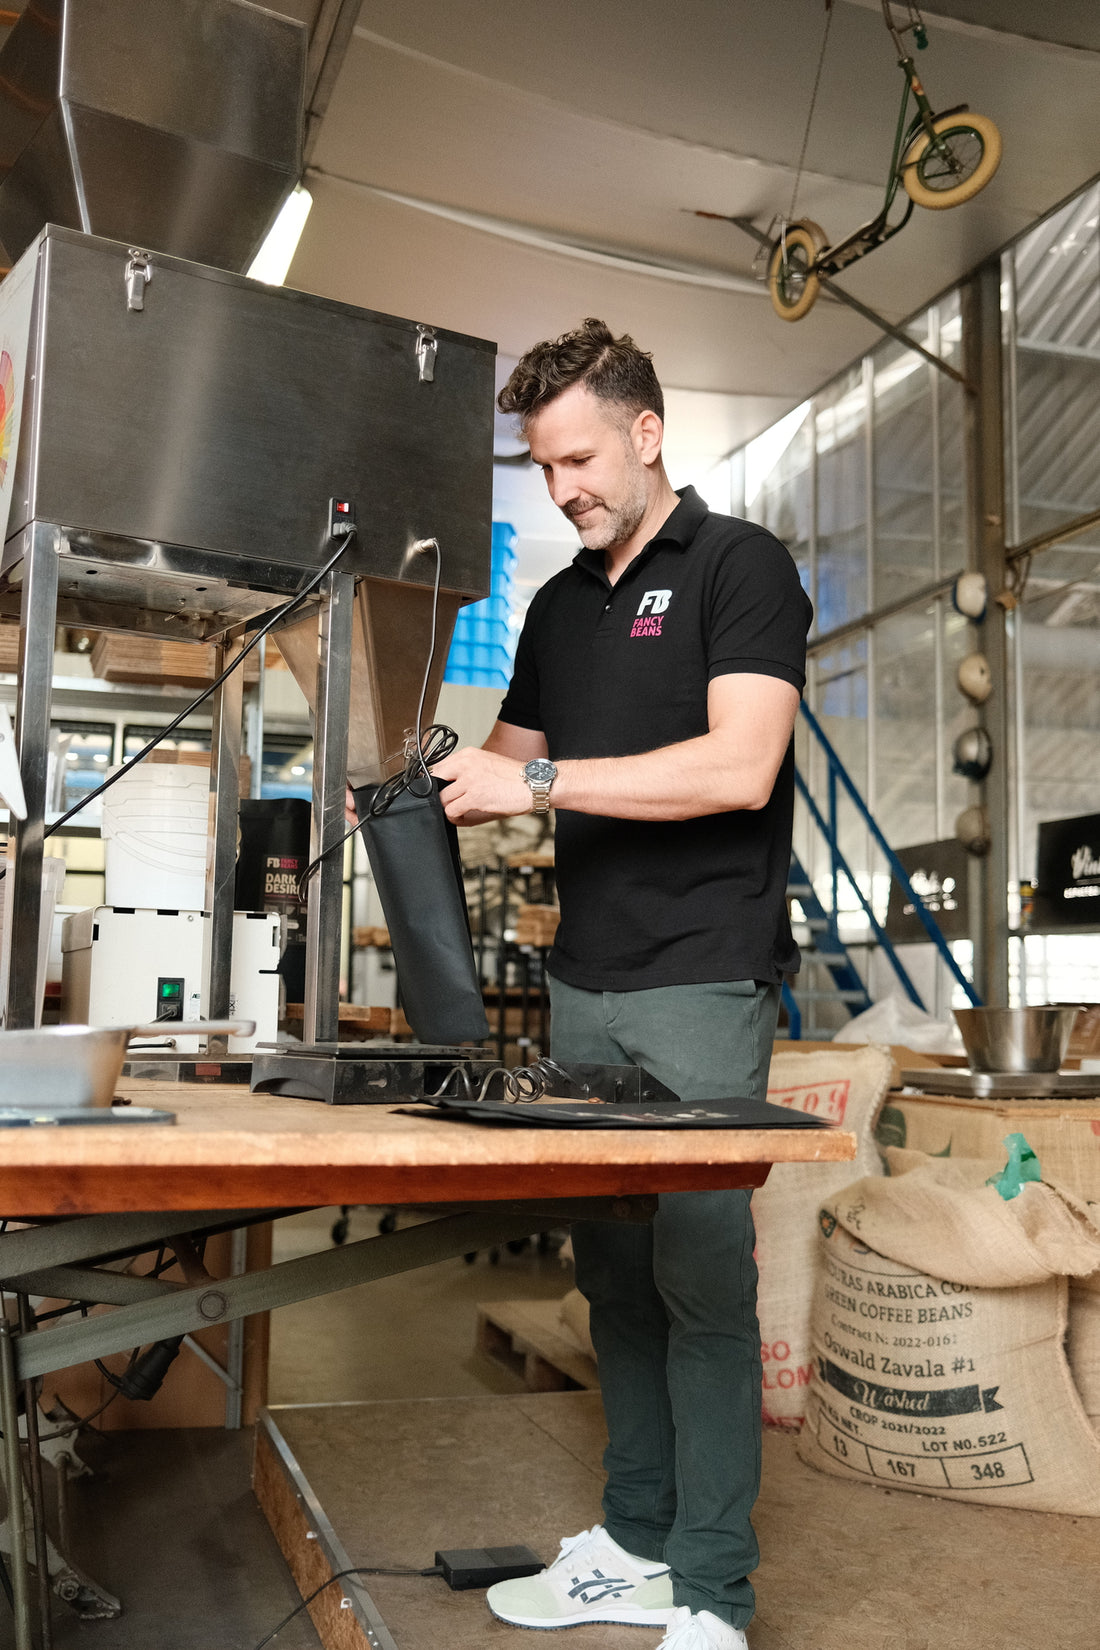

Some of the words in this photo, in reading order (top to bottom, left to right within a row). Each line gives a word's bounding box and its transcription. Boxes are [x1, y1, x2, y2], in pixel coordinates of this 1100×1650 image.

[636, 589, 673, 616] FB
[630, 626, 662, 637] BEANS
[632, 616, 664, 627] FANCY
[266, 857, 280, 868] FB
[265, 873, 296, 884] DARK
[867, 1281, 937, 1299] ARABICA
[825, 1284, 856, 1312] GREEN
[859, 1302, 912, 1323] COFFEE
[918, 1302, 973, 1324] BEANS
[824, 1331, 876, 1371] Oswald
[880, 1357, 945, 1377] Zavala
[951, 1357, 976, 1374] #1
[853, 1381, 931, 1411] Washed
[850, 1406, 878, 1424] CROP
[881, 1420, 946, 1436] 2021/2022
[833, 1435, 848, 1457] 13
[886, 1459, 916, 1477] 167
[970, 1461, 1005, 1480] 348
[922, 1441, 947, 1452] LOT
